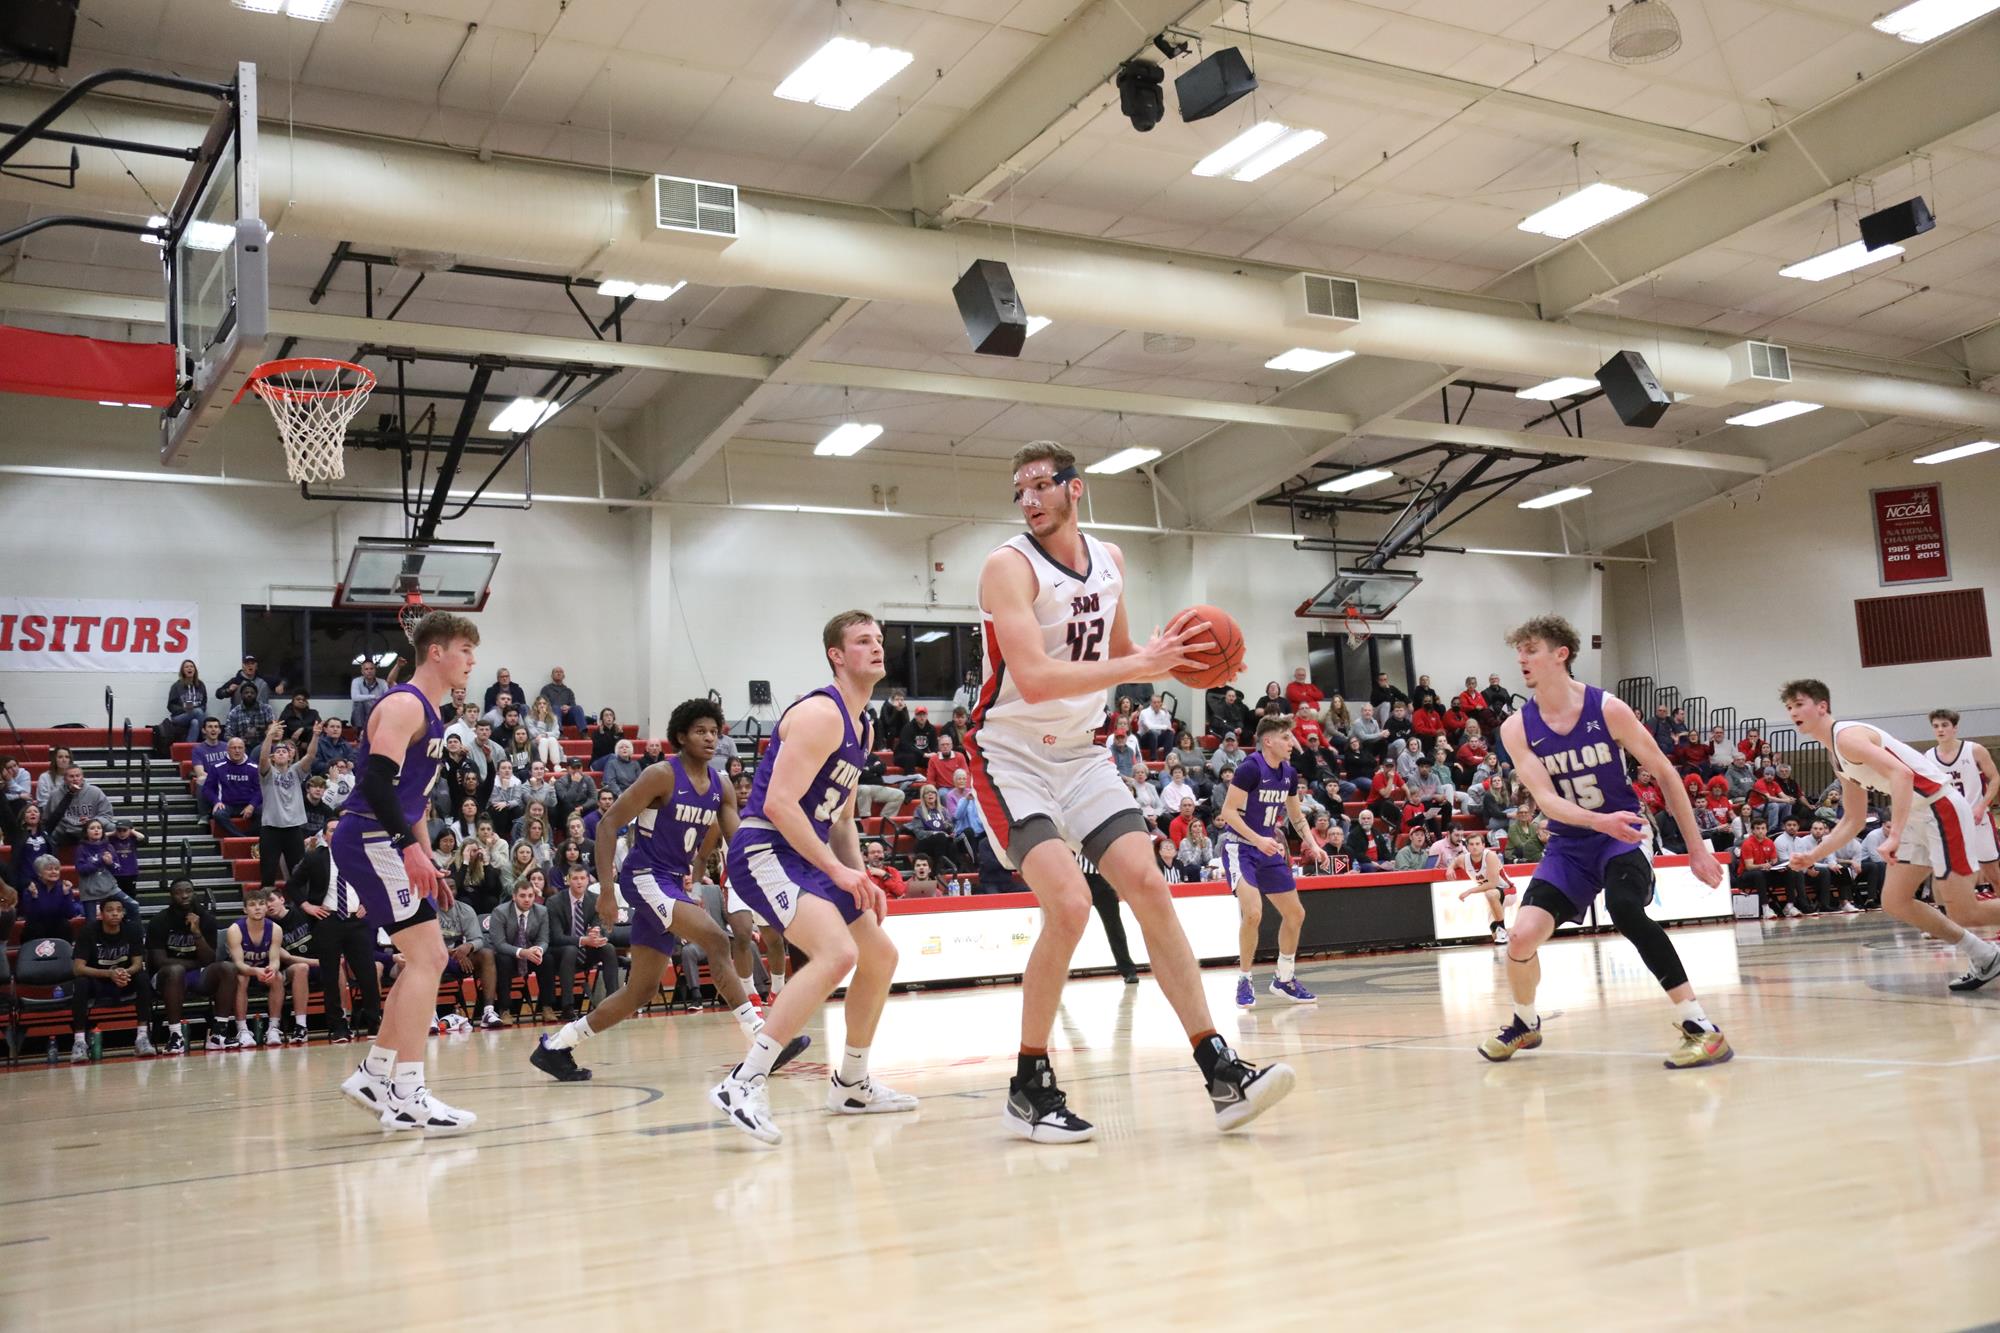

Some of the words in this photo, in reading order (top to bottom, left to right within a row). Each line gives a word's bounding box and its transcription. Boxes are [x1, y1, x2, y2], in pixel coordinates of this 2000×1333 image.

[1886, 504, 1931, 518] NCCAA
[1887, 526, 1934, 537] NATIONAL
[1884, 533, 1939, 545] CHAMPIONS
[1888, 545, 1910, 553] 1985
[1915, 542, 1940, 551] 2000
[1888, 554, 1911, 562] 2010
[1917, 551, 1941, 559] 2015
[1066, 617, 1105, 662] 42
[1538, 742, 1613, 776] AYLOR
[1559, 773, 1605, 810] 15
[684, 827, 698, 853] 0
